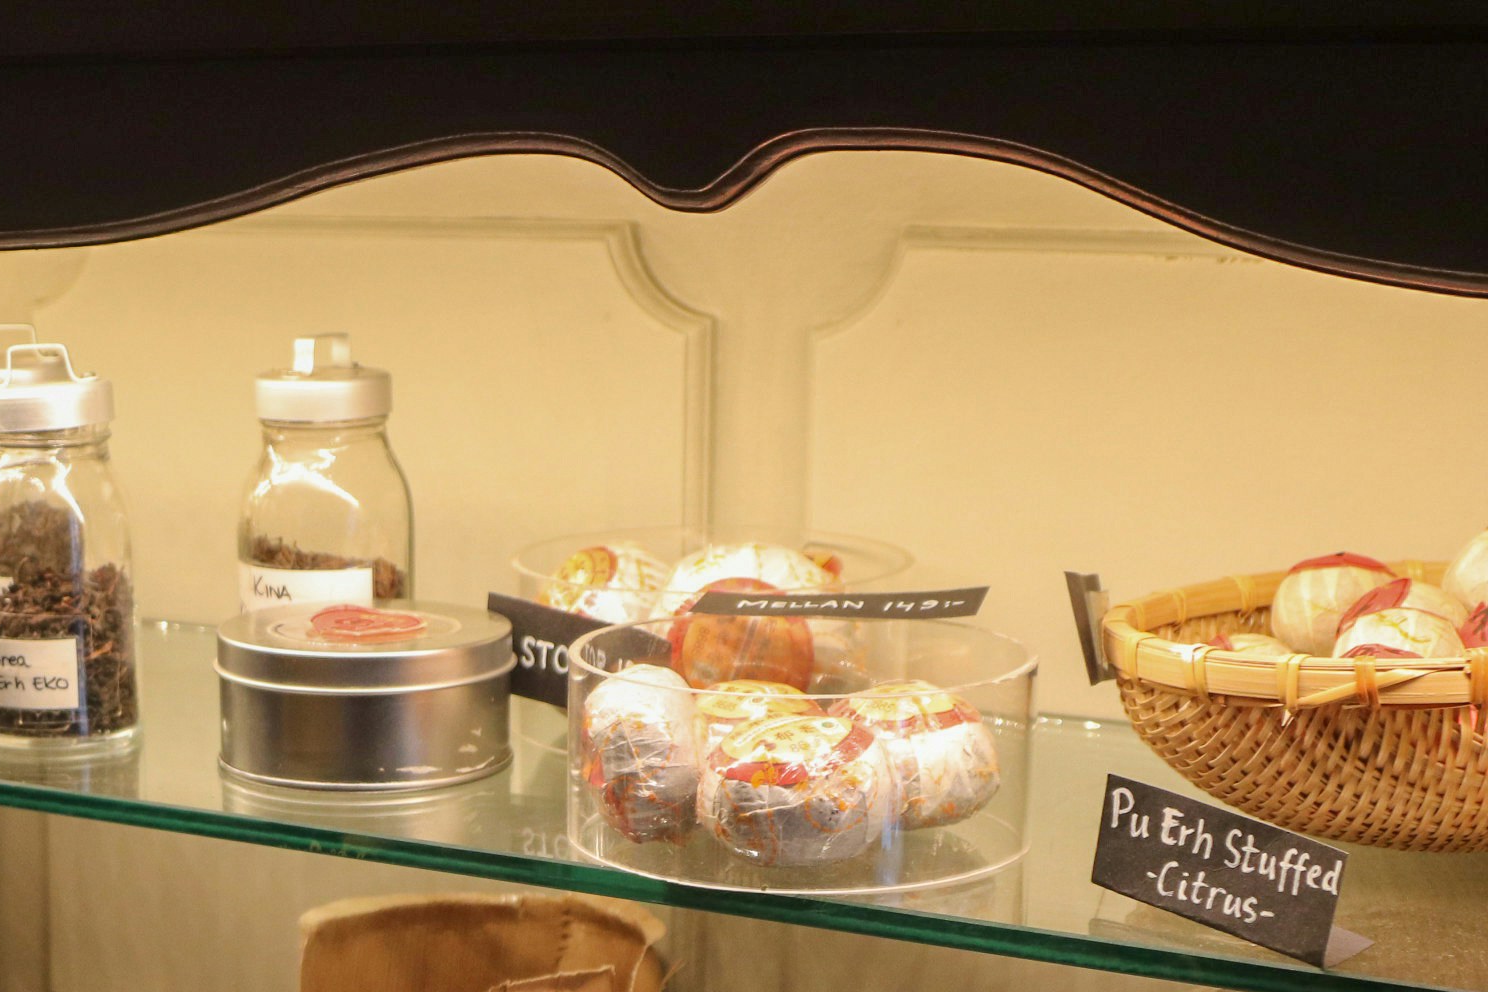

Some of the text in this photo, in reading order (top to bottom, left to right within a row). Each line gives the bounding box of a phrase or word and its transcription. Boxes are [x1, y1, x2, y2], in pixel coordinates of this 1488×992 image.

[253, 575, 292, 601] KINA
[737, 599, 864, 610] MELLAN
[33, 676, 69, 691] EKO
[1111, 787, 1343, 897] Pu Erh Stuffed
